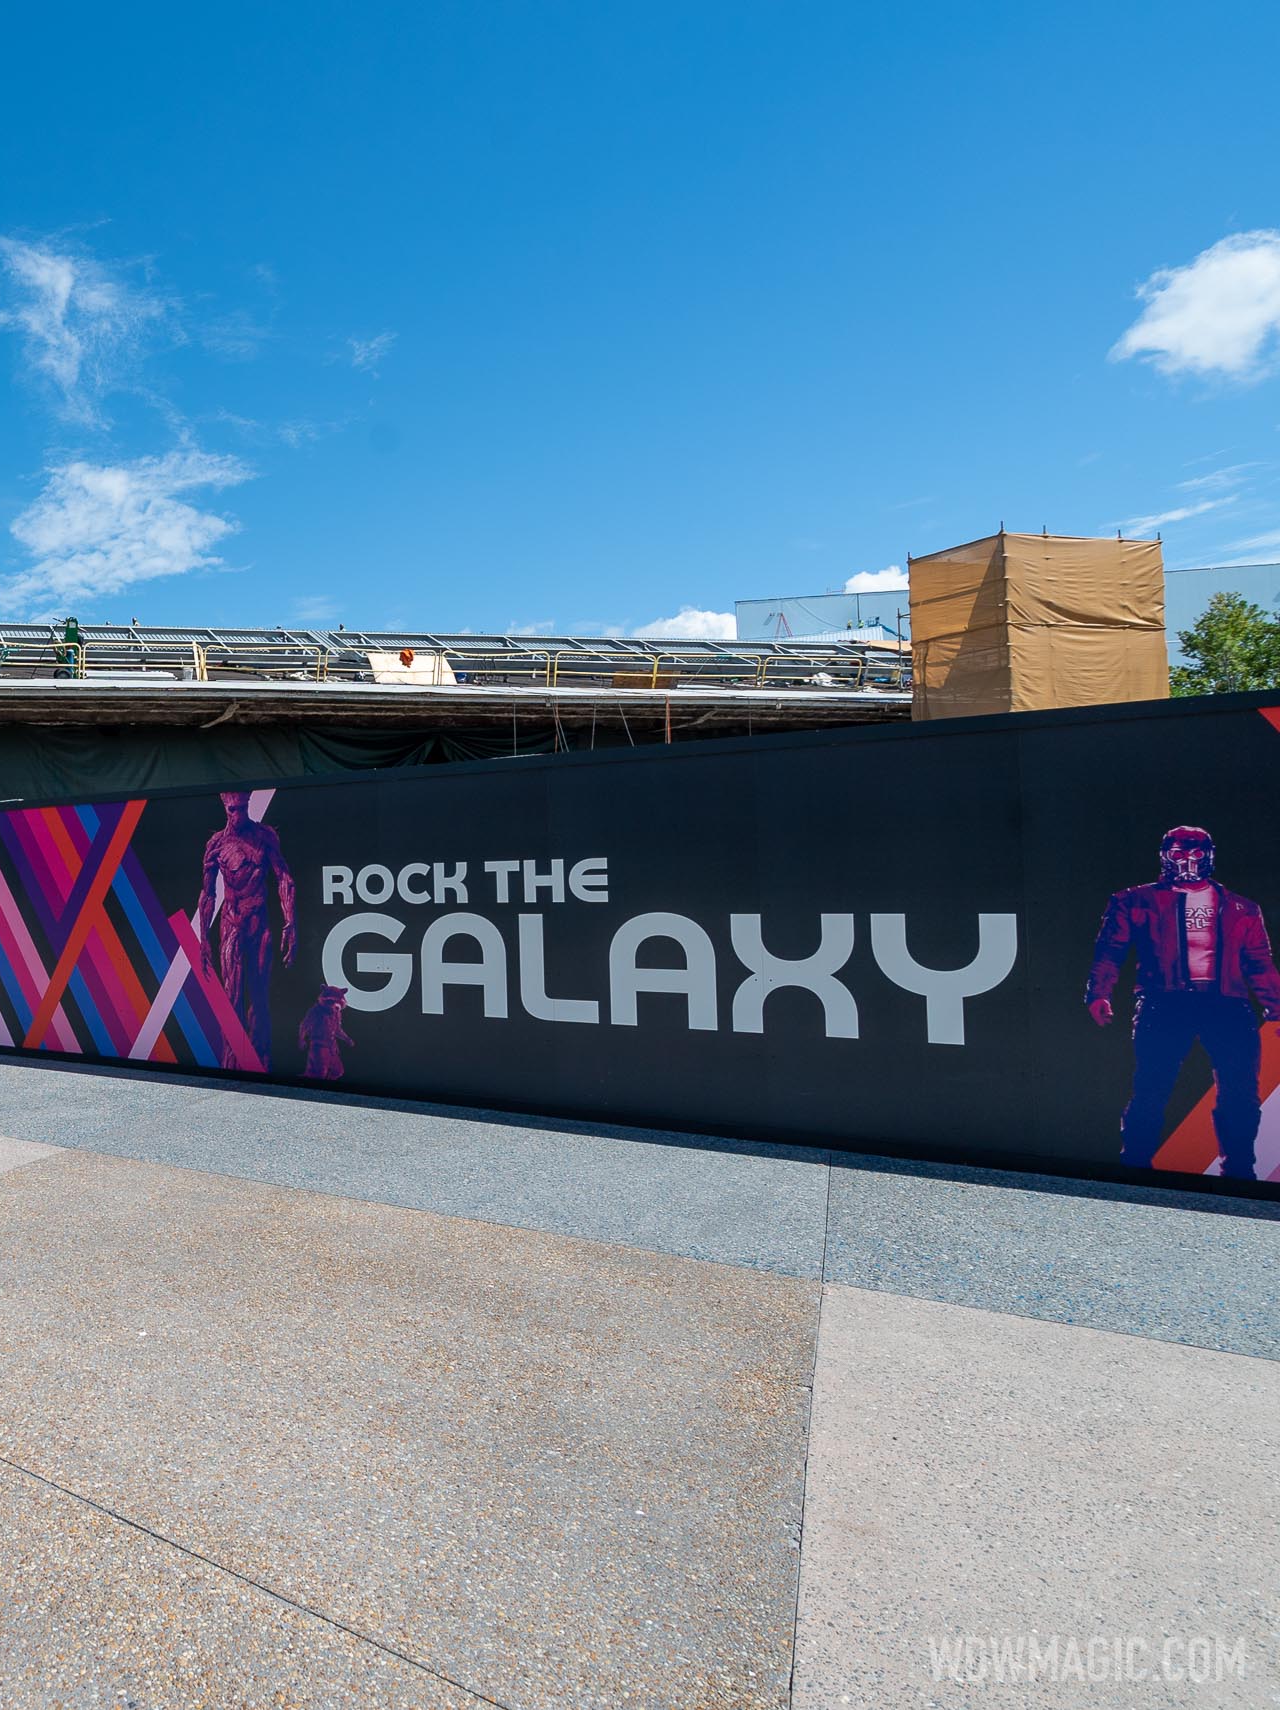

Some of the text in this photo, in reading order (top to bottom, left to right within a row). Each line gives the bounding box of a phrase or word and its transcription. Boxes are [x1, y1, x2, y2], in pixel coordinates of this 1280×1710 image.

[322, 857, 609, 905] ROCK THE
[322, 911, 1018, 1046] GALAXY
